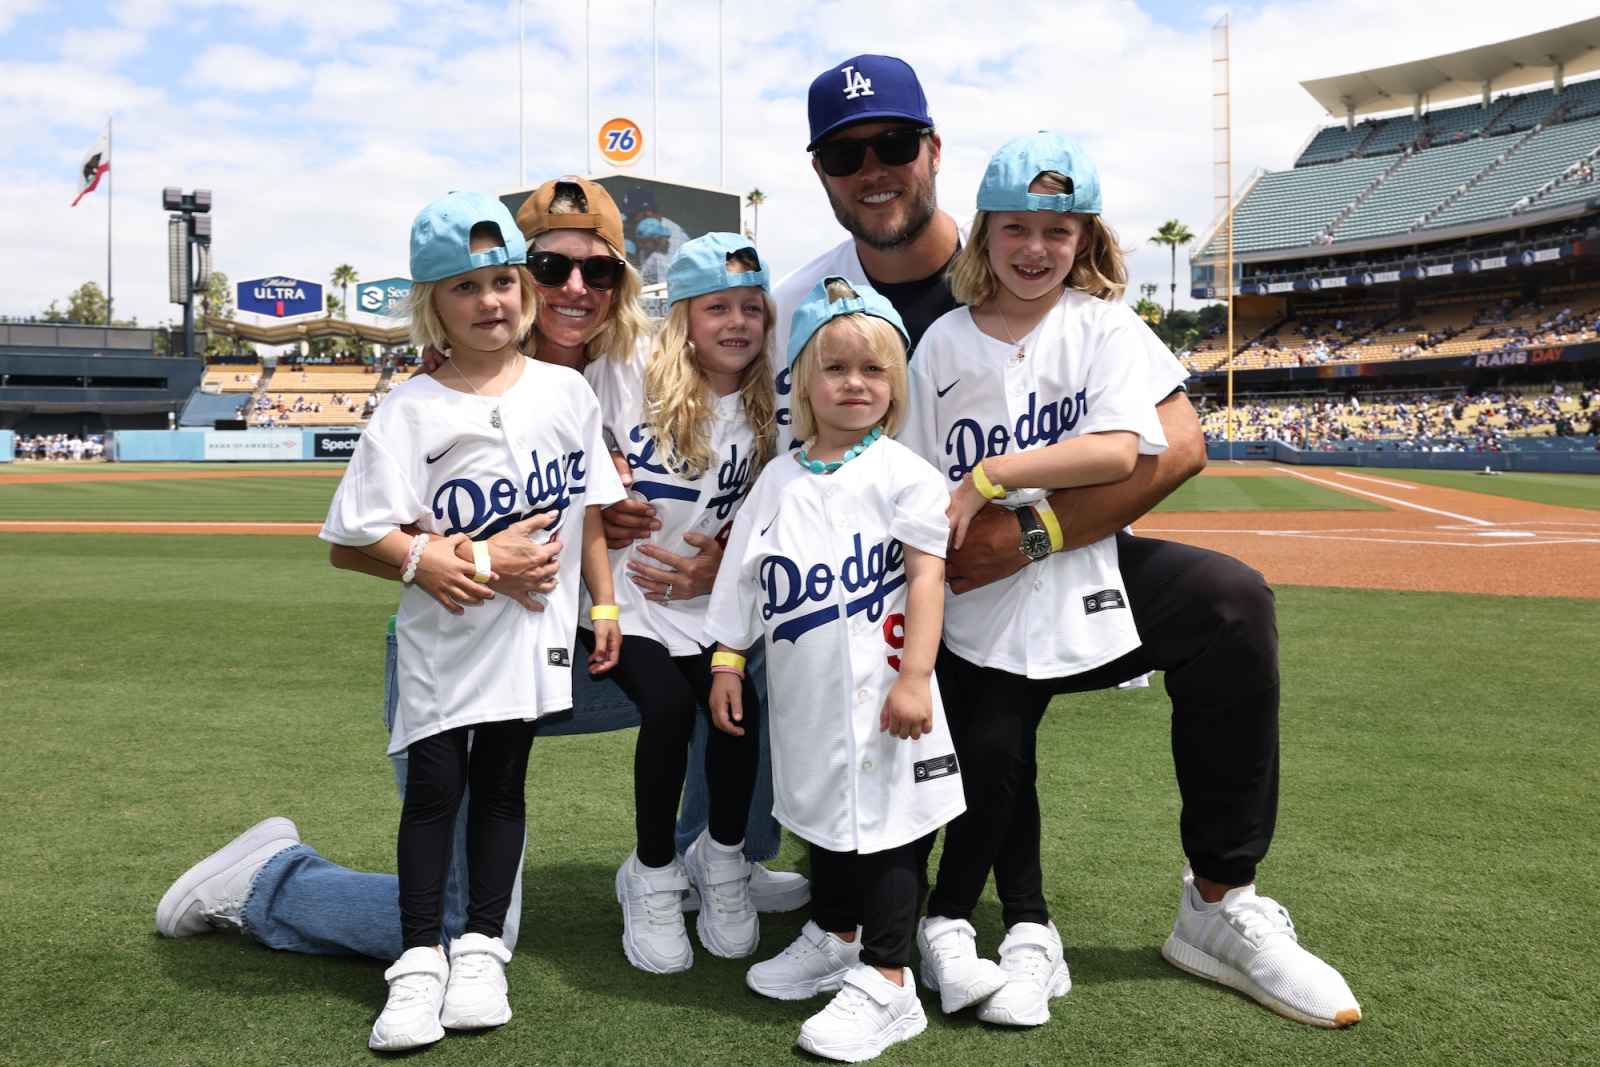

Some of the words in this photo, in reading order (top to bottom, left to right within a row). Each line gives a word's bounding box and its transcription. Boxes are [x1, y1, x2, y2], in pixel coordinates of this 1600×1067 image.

[841, 65, 875, 100] LA
[606, 129, 635, 151] 76
[254, 287, 306, 300] ULTRA
[1475, 351, 1528, 368] RAMS
[1531, 348, 1564, 364] DAY
